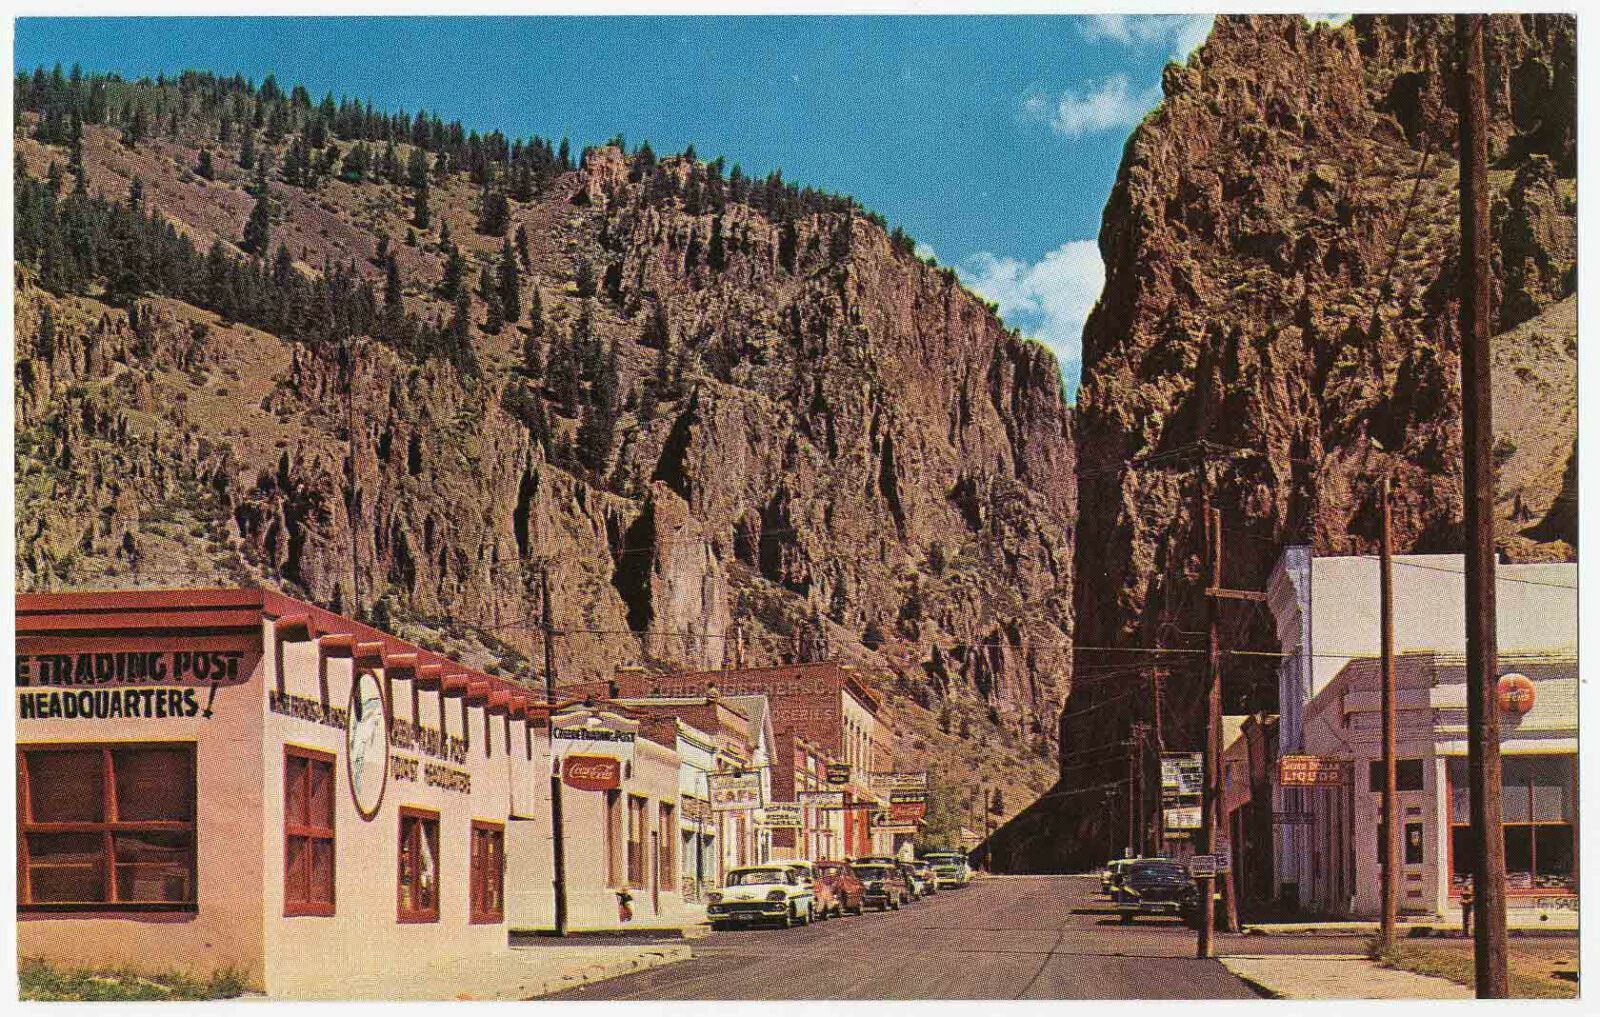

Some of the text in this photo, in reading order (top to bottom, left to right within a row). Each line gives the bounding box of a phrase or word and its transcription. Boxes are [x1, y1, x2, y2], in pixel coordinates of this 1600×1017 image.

[36, 654, 167, 686] TRADING
[173, 651, 244, 682] POST
[615, 729, 635, 742] POST
[569, 763, 614, 780] Coca-Cola
[1284, 771, 1338, 782] LIQUOR
